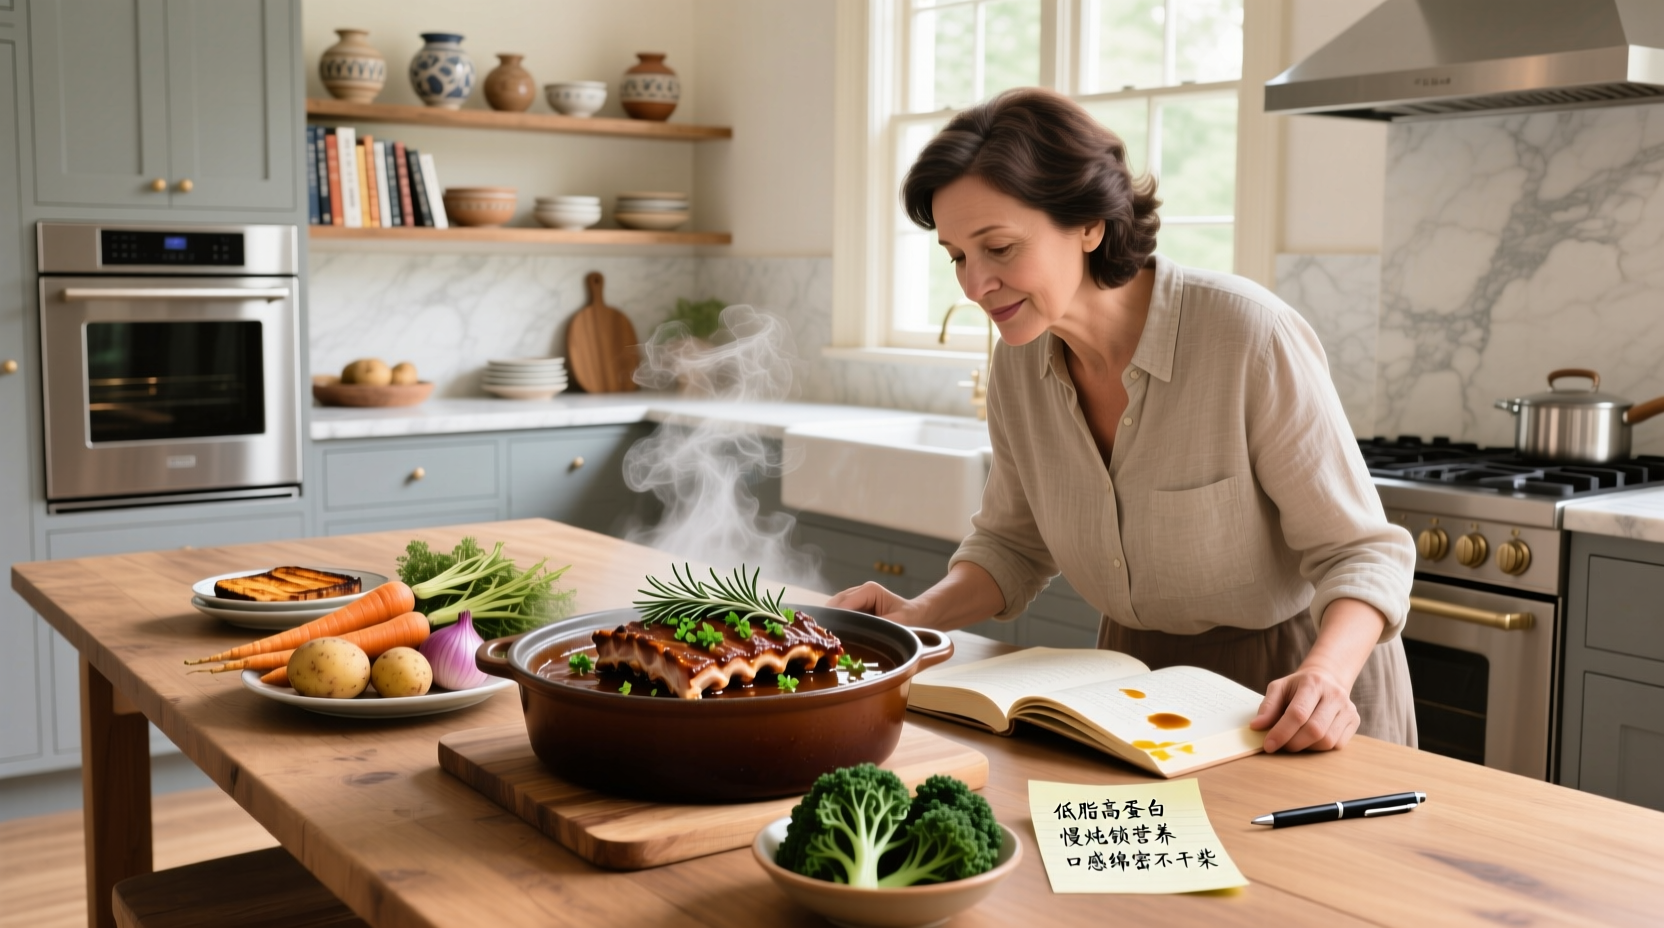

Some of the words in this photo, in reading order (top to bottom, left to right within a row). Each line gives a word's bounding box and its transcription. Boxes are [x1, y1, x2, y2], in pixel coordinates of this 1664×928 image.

[1053, 799, 1164, 820] 低脂高蛋白
[1059, 823, 1176, 847] 慢炖锁营养
[1066, 848, 1219, 872] 口感绵密不干柴
